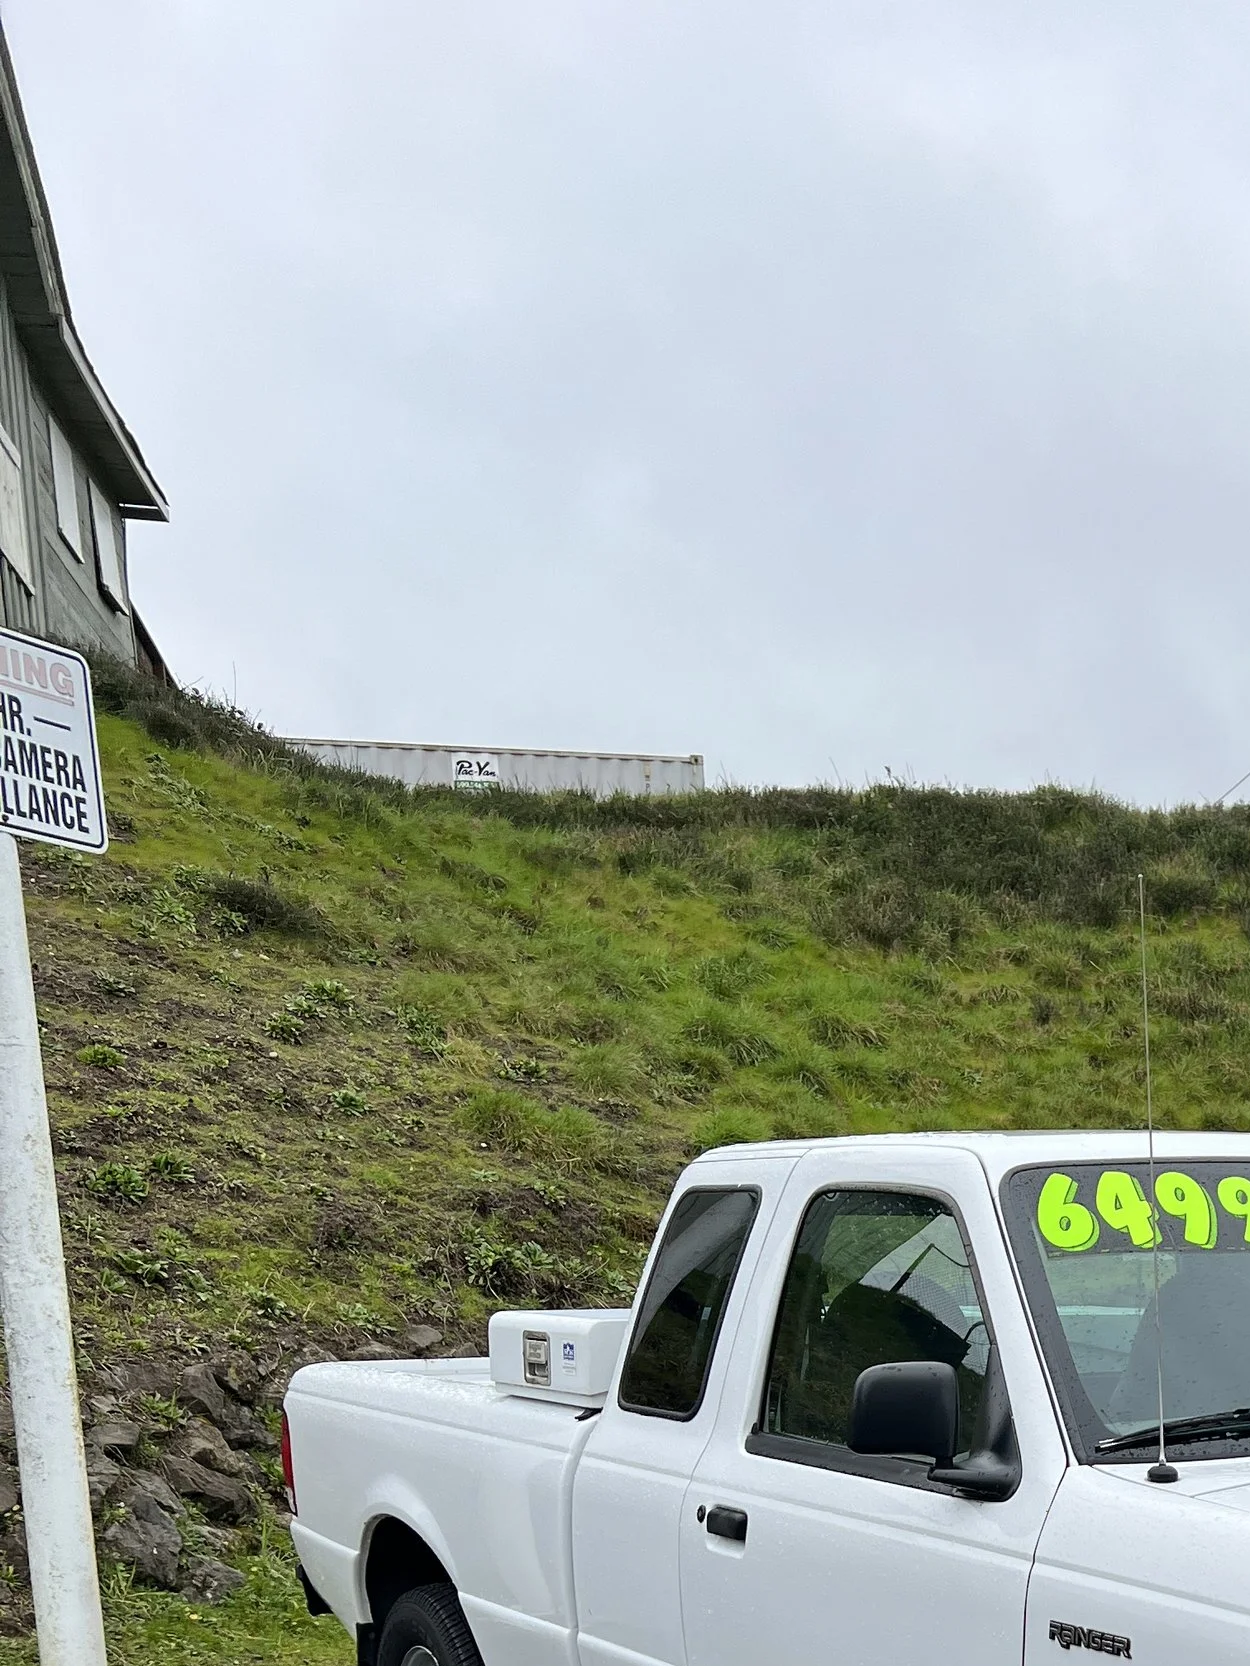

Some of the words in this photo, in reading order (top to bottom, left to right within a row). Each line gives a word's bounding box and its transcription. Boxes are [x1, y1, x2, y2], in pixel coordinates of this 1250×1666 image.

[0, 735, 87, 793] AMERA
[456, 760, 497, 777] Pac-Van
[1049, 1619, 1133, 1660] RANGER
